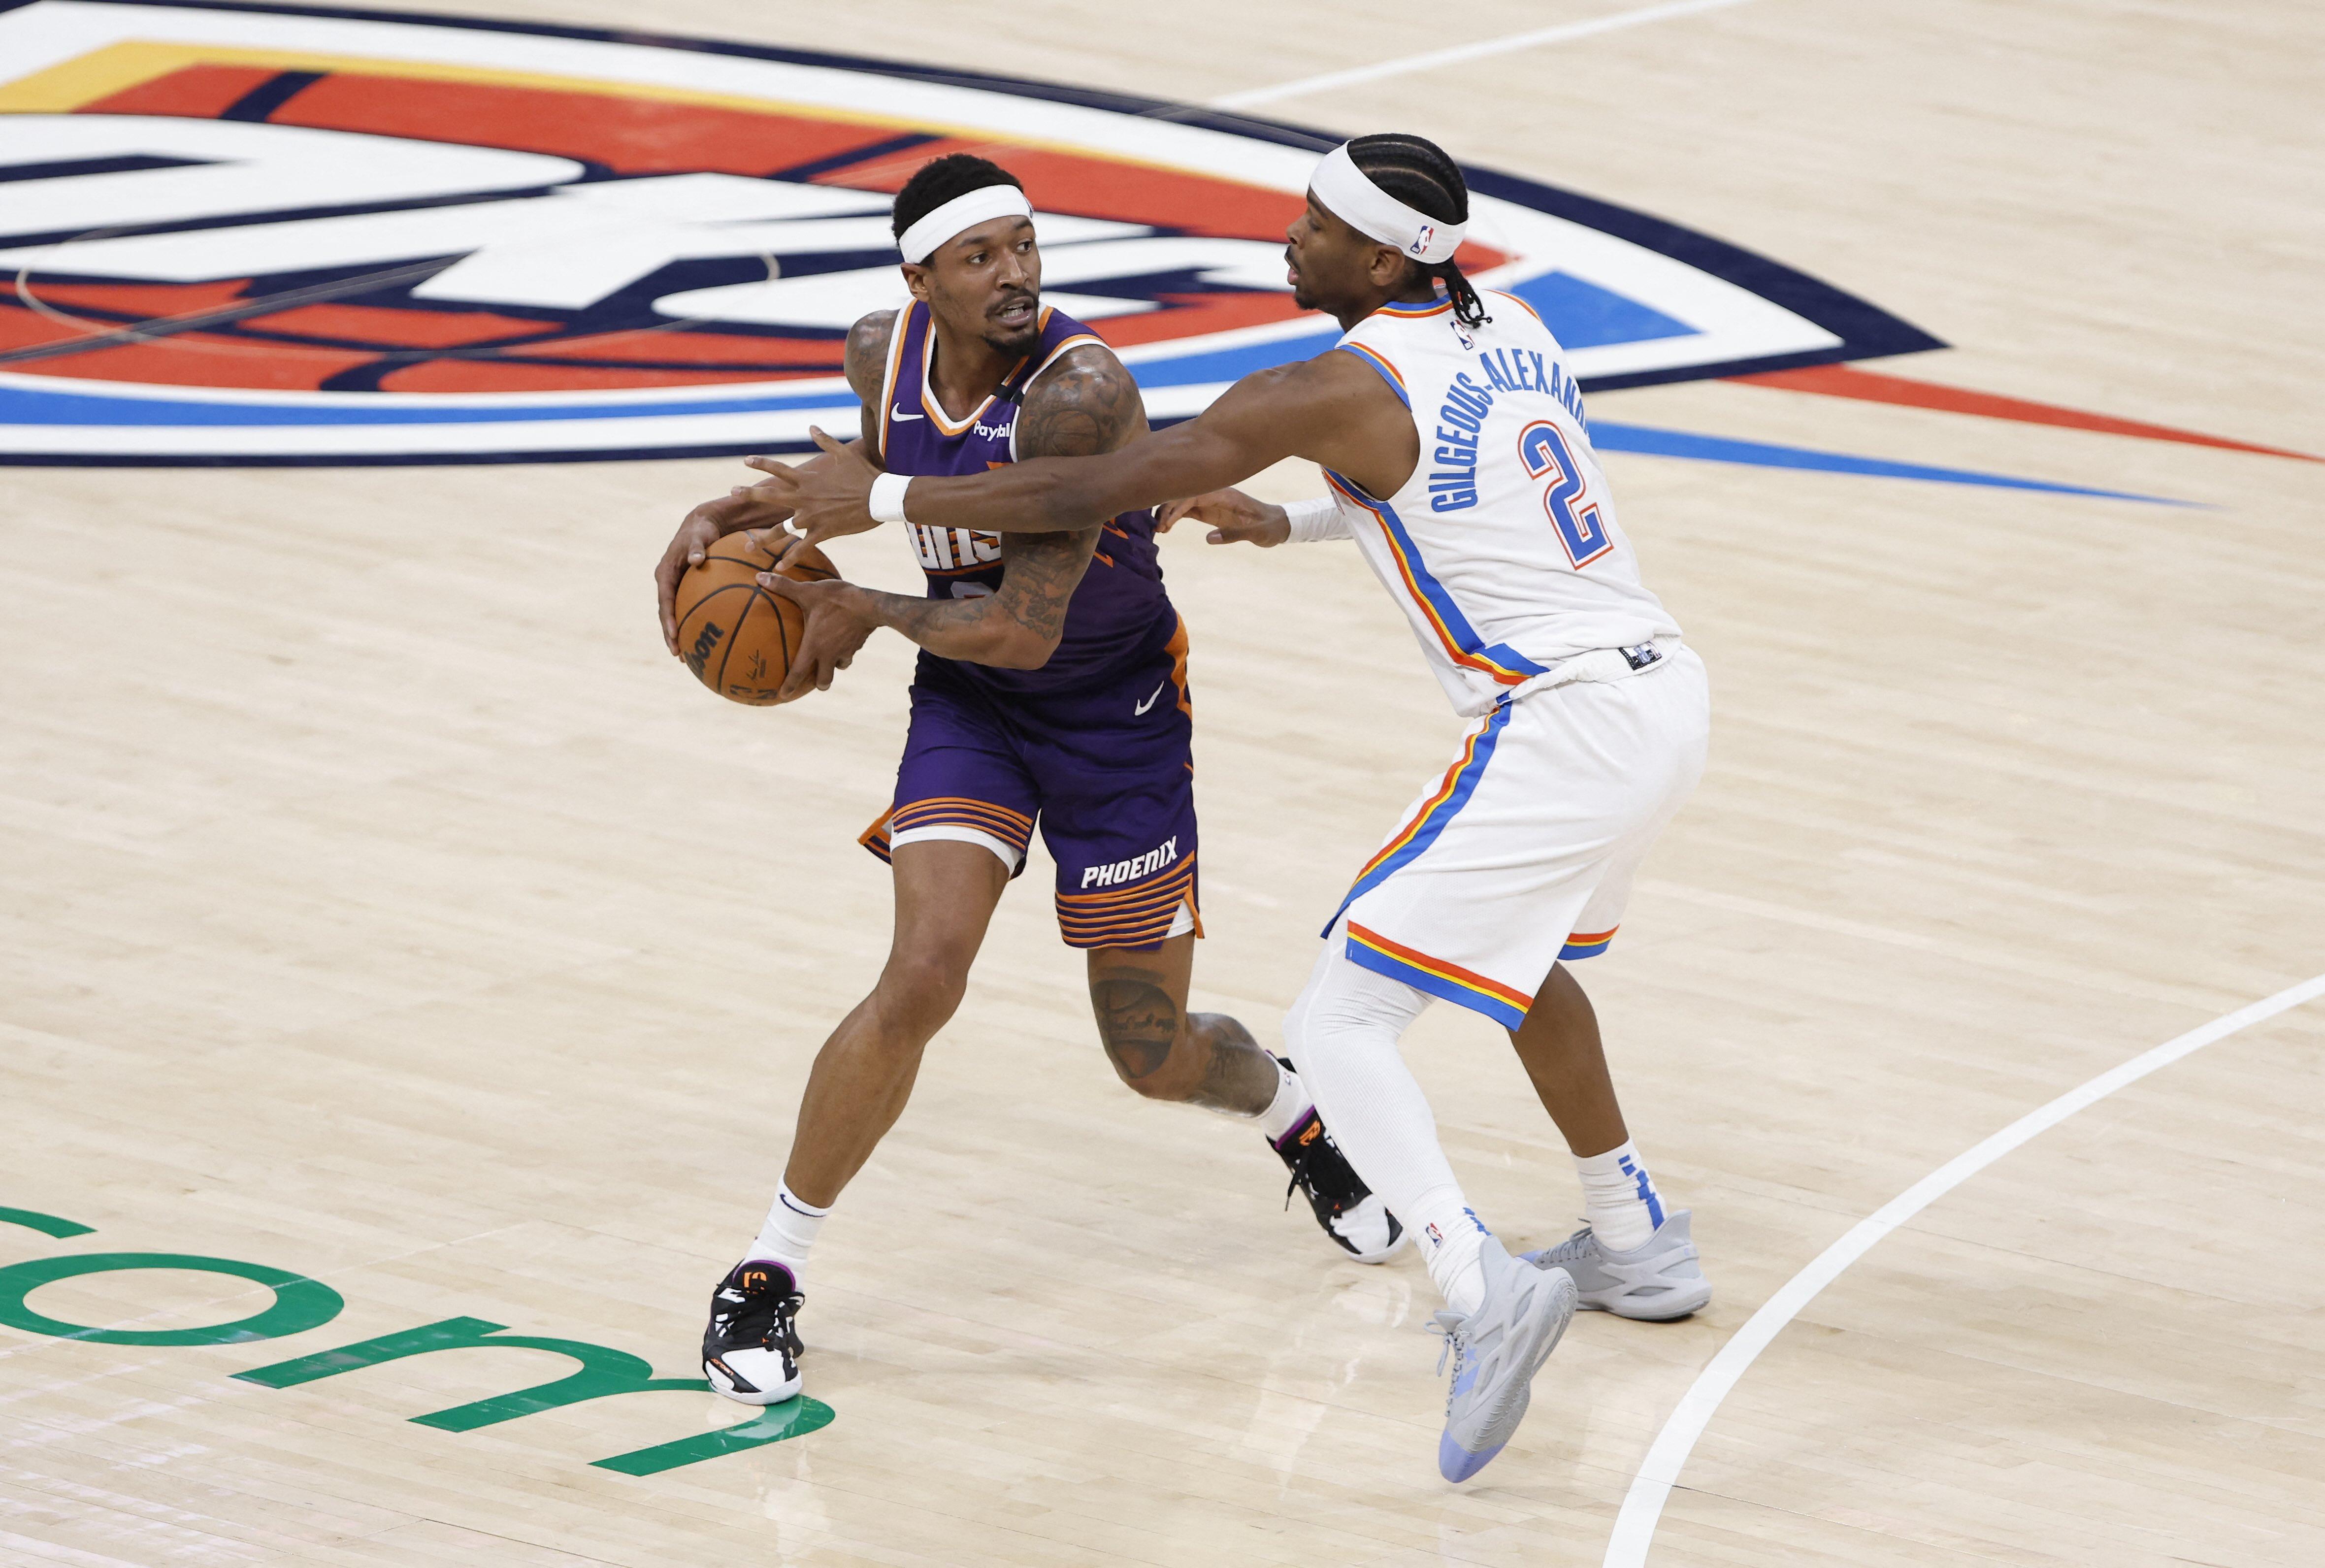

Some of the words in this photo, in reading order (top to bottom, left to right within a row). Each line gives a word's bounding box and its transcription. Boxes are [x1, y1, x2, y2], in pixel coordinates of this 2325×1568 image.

[1517, 420, 1614, 570] 2
[1081, 835, 1178, 888] PHOENIX
[0, 1206, 836, 1477] om
